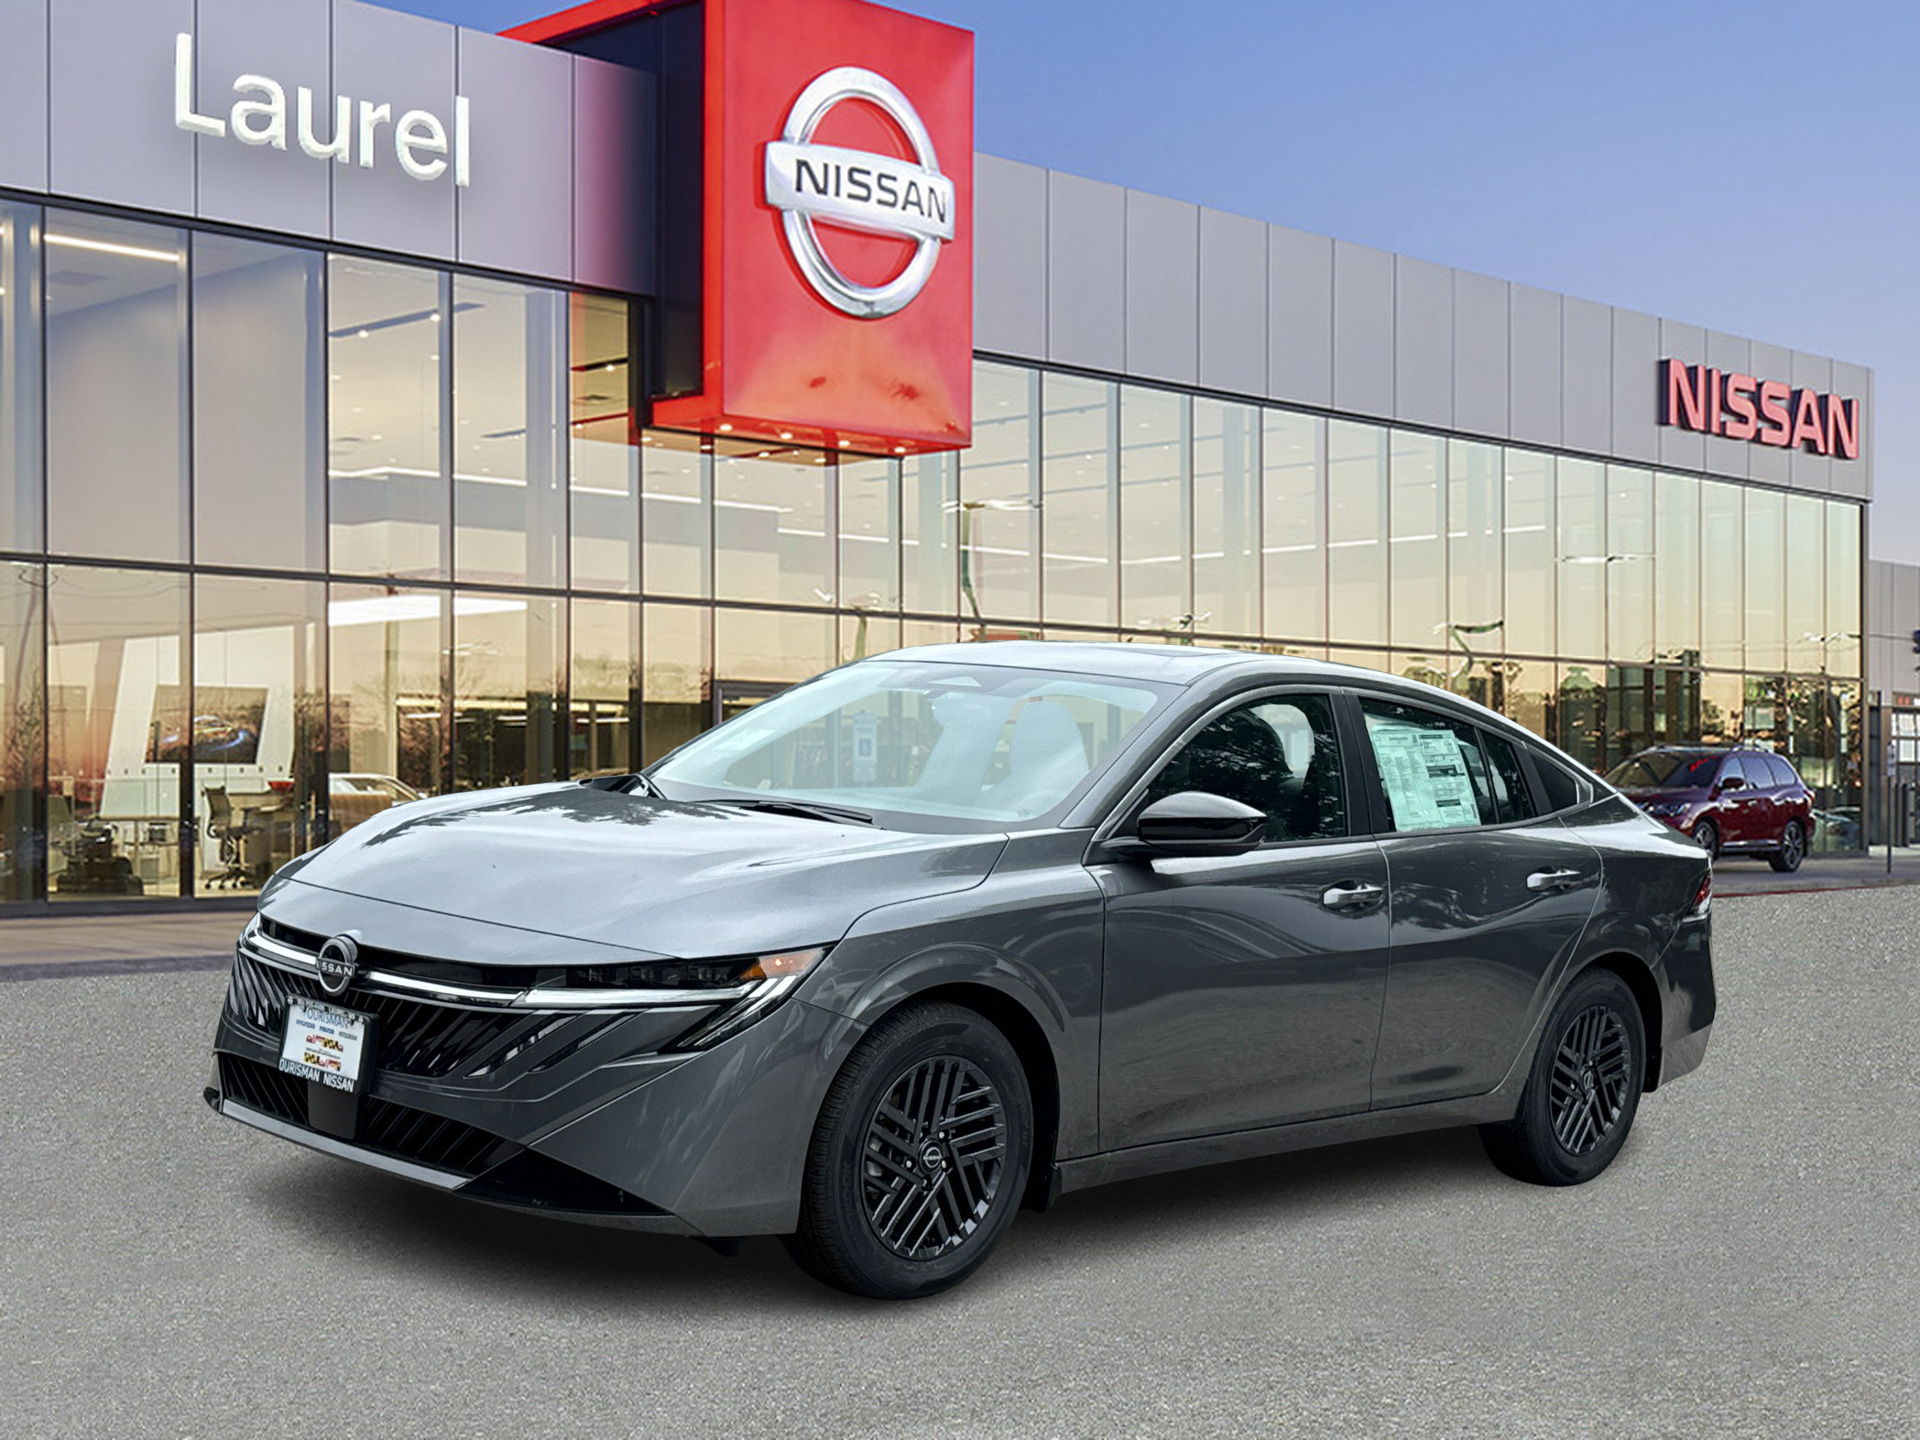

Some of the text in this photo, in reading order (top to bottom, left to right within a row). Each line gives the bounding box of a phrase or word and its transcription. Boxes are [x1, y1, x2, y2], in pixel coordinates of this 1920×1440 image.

[174, 32, 470, 188] Laurel
[795, 158, 947, 224] NISSAN
[1657, 357, 1860, 461] NISSAN
[316, 960, 354, 977] SSAN
[278, 1058, 355, 1093] OURISMAN NISSAN
